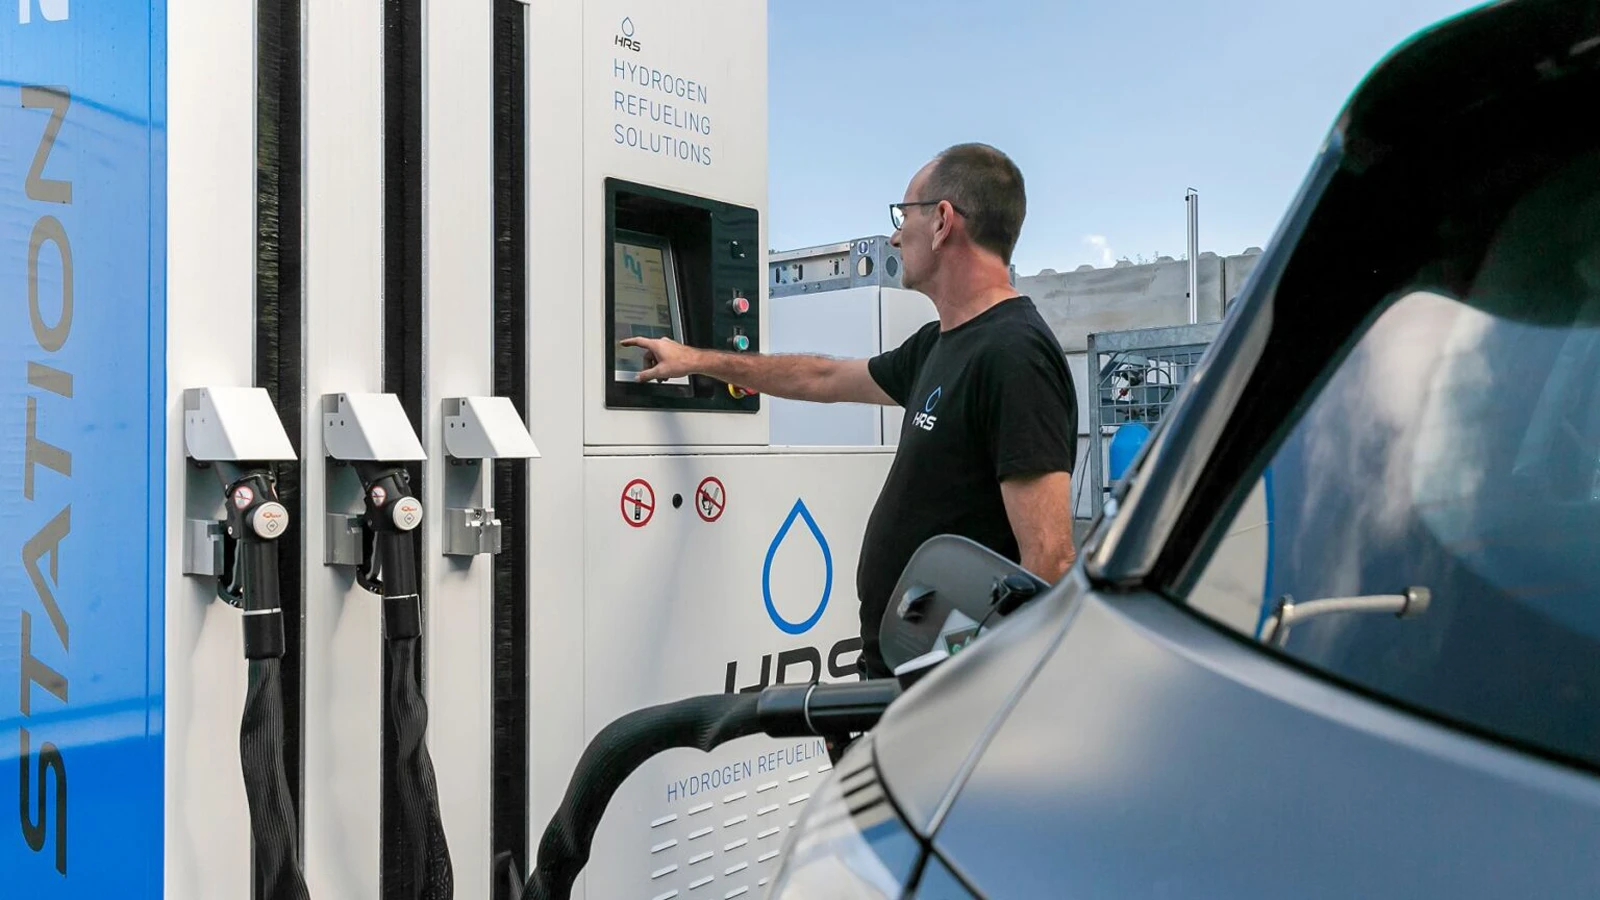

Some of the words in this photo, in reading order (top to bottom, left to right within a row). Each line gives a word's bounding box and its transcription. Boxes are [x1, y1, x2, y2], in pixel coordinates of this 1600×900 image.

[614, 35, 641, 52] HRS
[614, 58, 707, 104] HYDROGEN
[614, 91, 711, 135] REFUELING
[614, 124, 712, 166] SOLUTIONS
[912, 411, 938, 431] HRS
[19, 84, 74, 878] STATION
[667, 760, 752, 803] HYDROGEN
